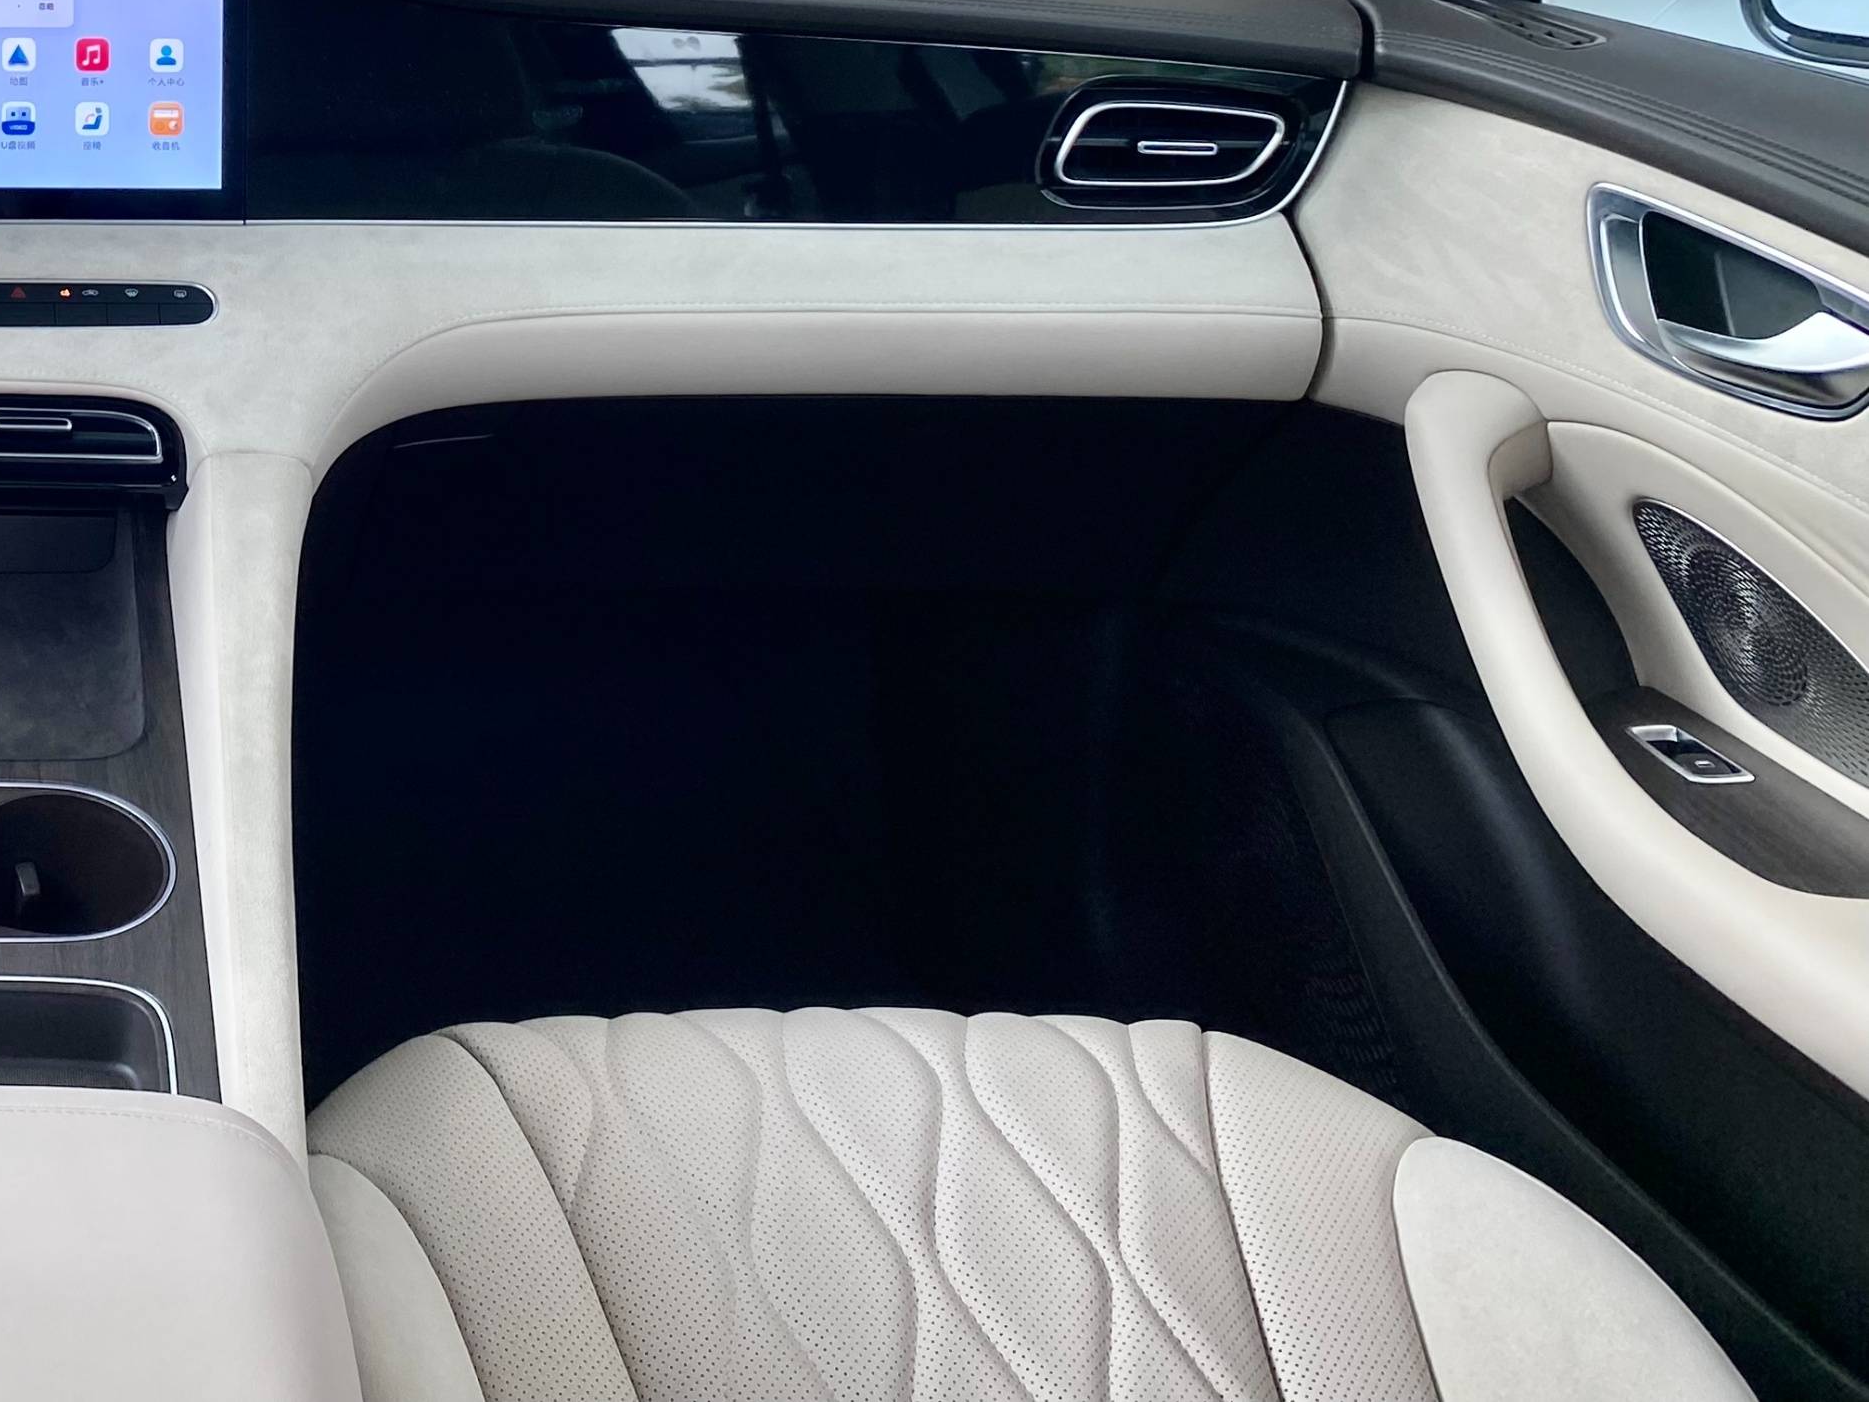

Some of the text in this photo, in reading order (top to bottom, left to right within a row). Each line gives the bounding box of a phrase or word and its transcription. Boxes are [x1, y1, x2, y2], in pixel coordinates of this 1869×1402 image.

[9, 76, 28, 86] 地图
[148, 77, 185, 87] 个人中心
